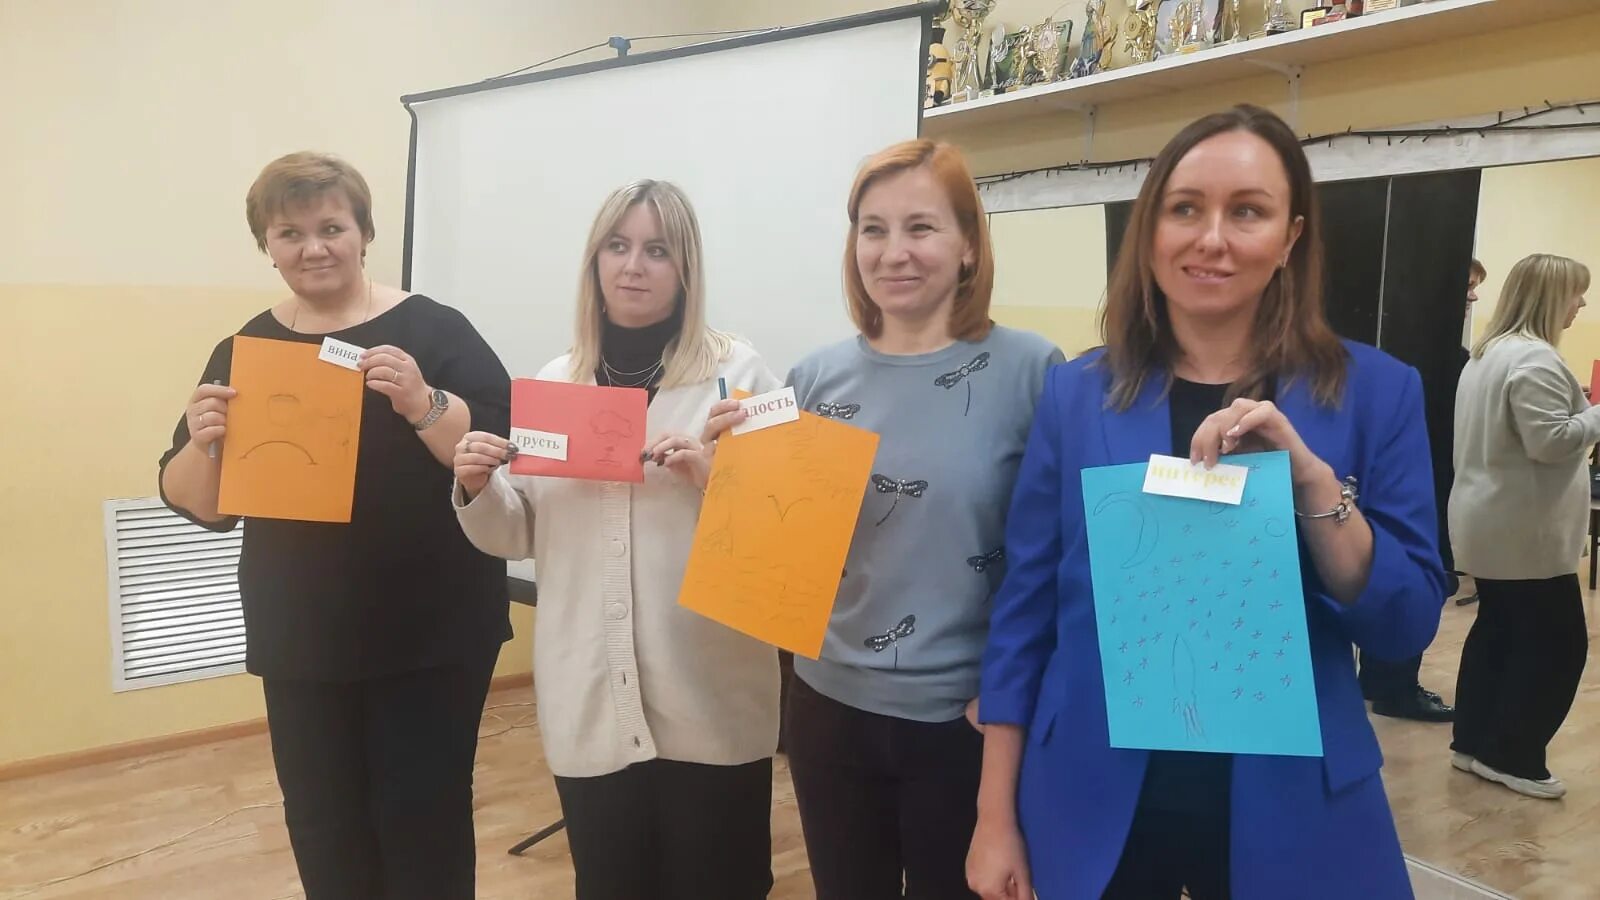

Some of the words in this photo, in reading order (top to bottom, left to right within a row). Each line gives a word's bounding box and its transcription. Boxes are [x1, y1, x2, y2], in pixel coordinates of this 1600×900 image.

[327, 345, 359, 361] вина
[742, 396, 795, 418] адость
[516, 434, 560, 450] грусть
